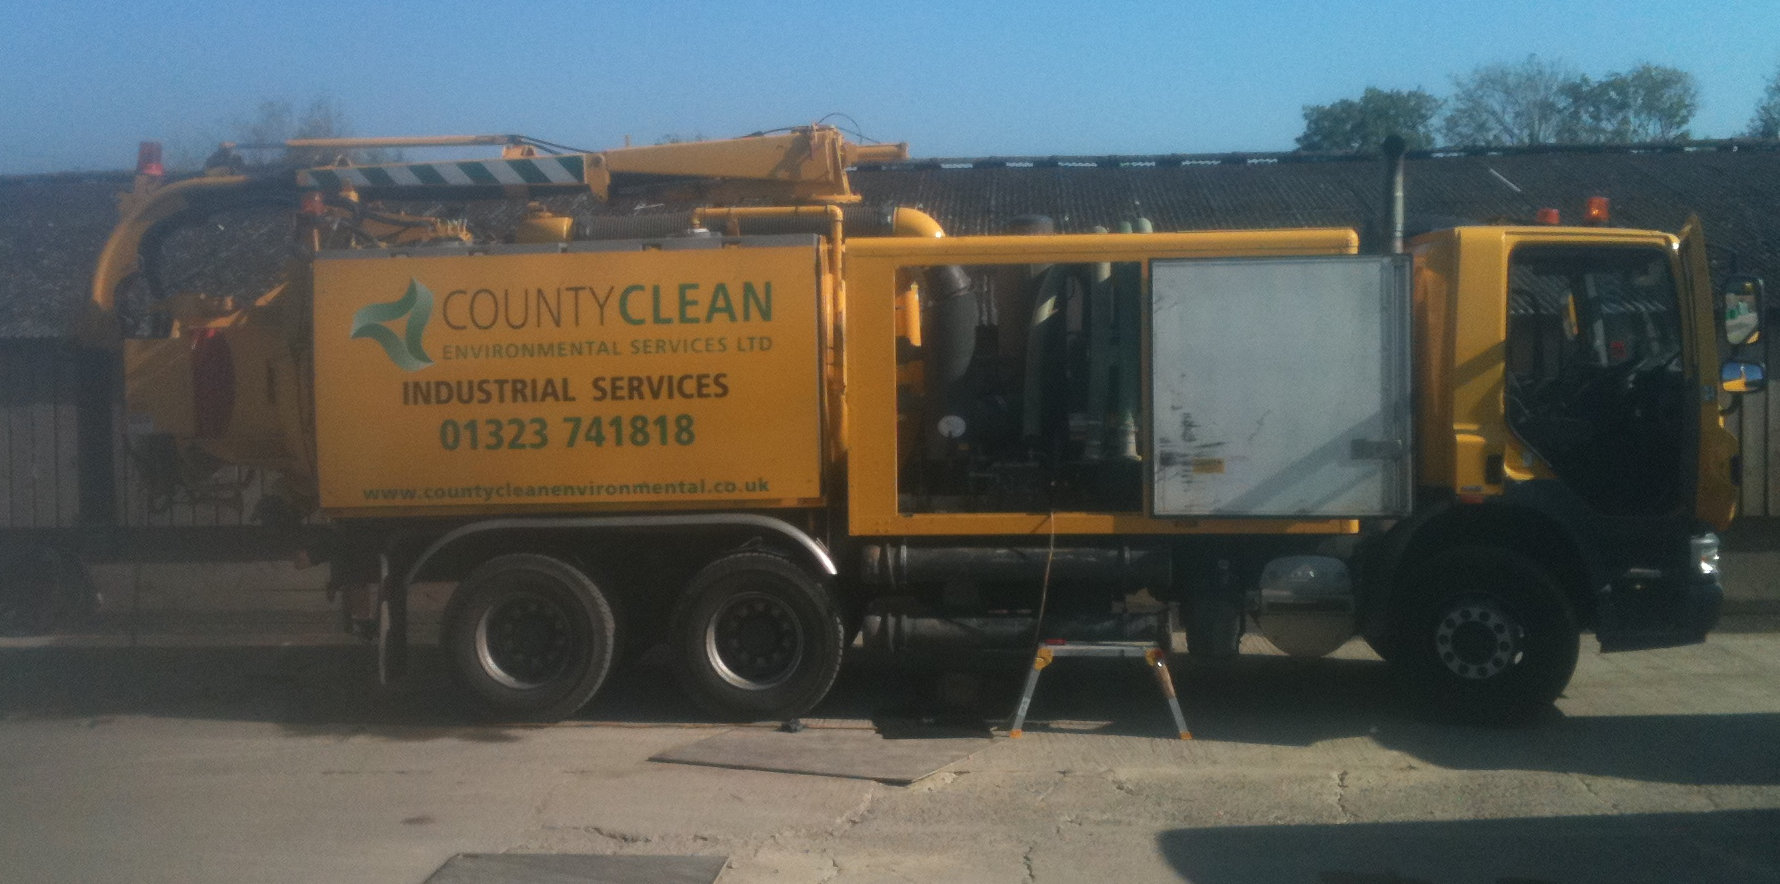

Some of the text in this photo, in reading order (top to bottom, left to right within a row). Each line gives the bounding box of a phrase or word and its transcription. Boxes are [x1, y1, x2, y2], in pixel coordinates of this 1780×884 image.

[442, 335, 773, 361] ENVIRONMENTAL SERVICES LTD
[403, 373, 729, 406] INDUSTRIAL SERVICES
[439, 414, 695, 451] 01323 741818
[363, 477, 769, 501] www.countycleanenvironmental.co.uk
